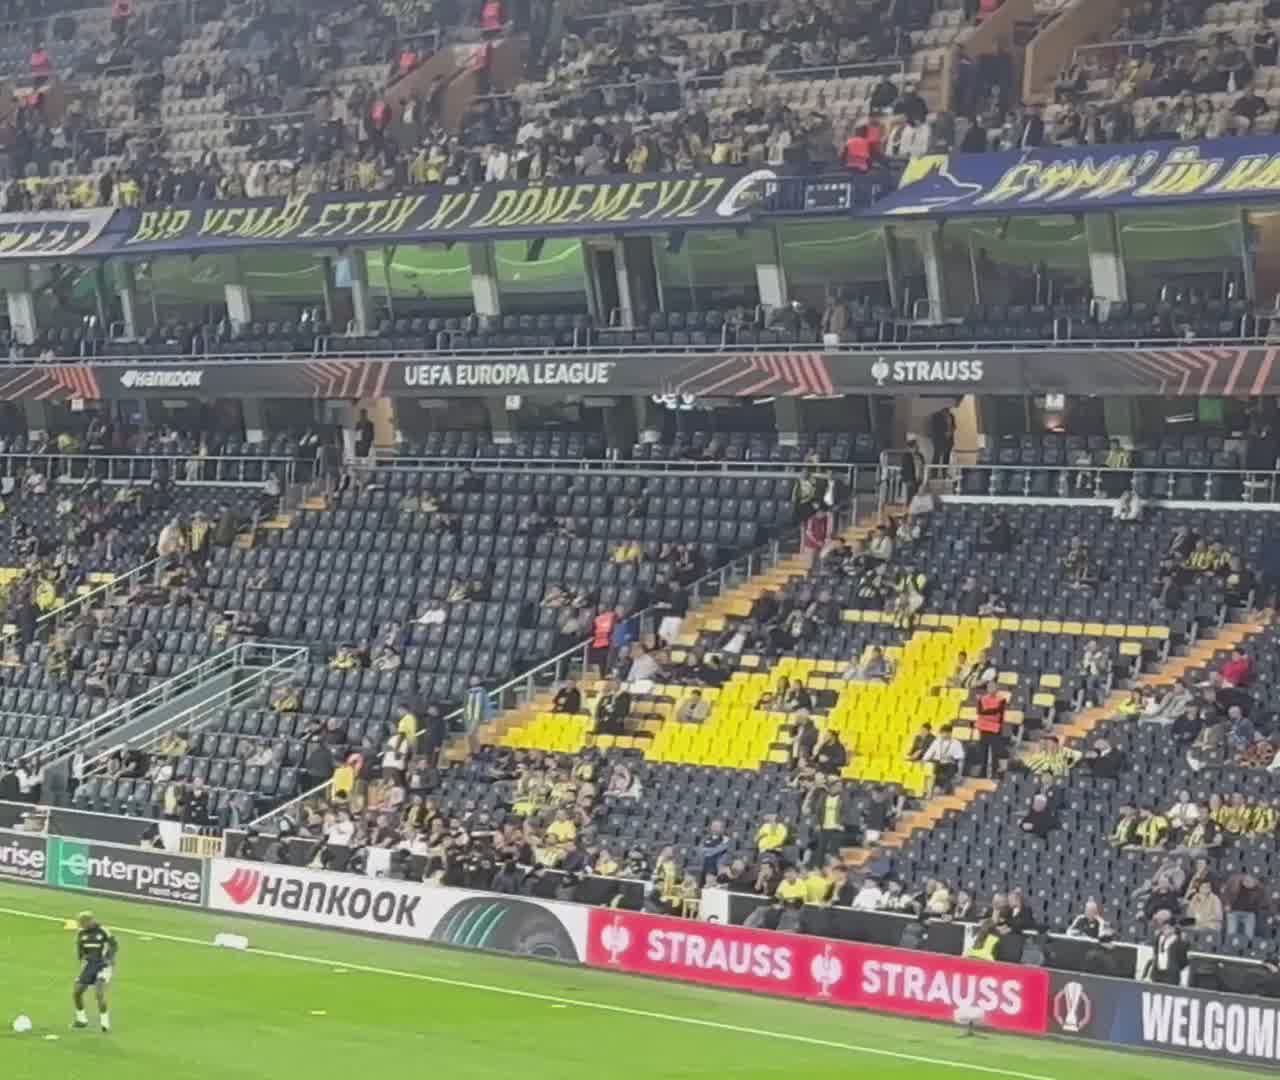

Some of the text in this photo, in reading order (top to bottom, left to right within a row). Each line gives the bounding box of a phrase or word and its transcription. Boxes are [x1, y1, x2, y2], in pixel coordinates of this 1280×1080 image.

[404, 362, 609, 386] UEFA EUROPA LEAGUE
[893, 361, 983, 381] STRAUSS
[68, 851, 200, 892] enterprise
[648, 929, 793, 981] STRAUSS
[861, 959, 1022, 1015] STRAUSS
[1142, 991, 1280, 1060] WELCOM
